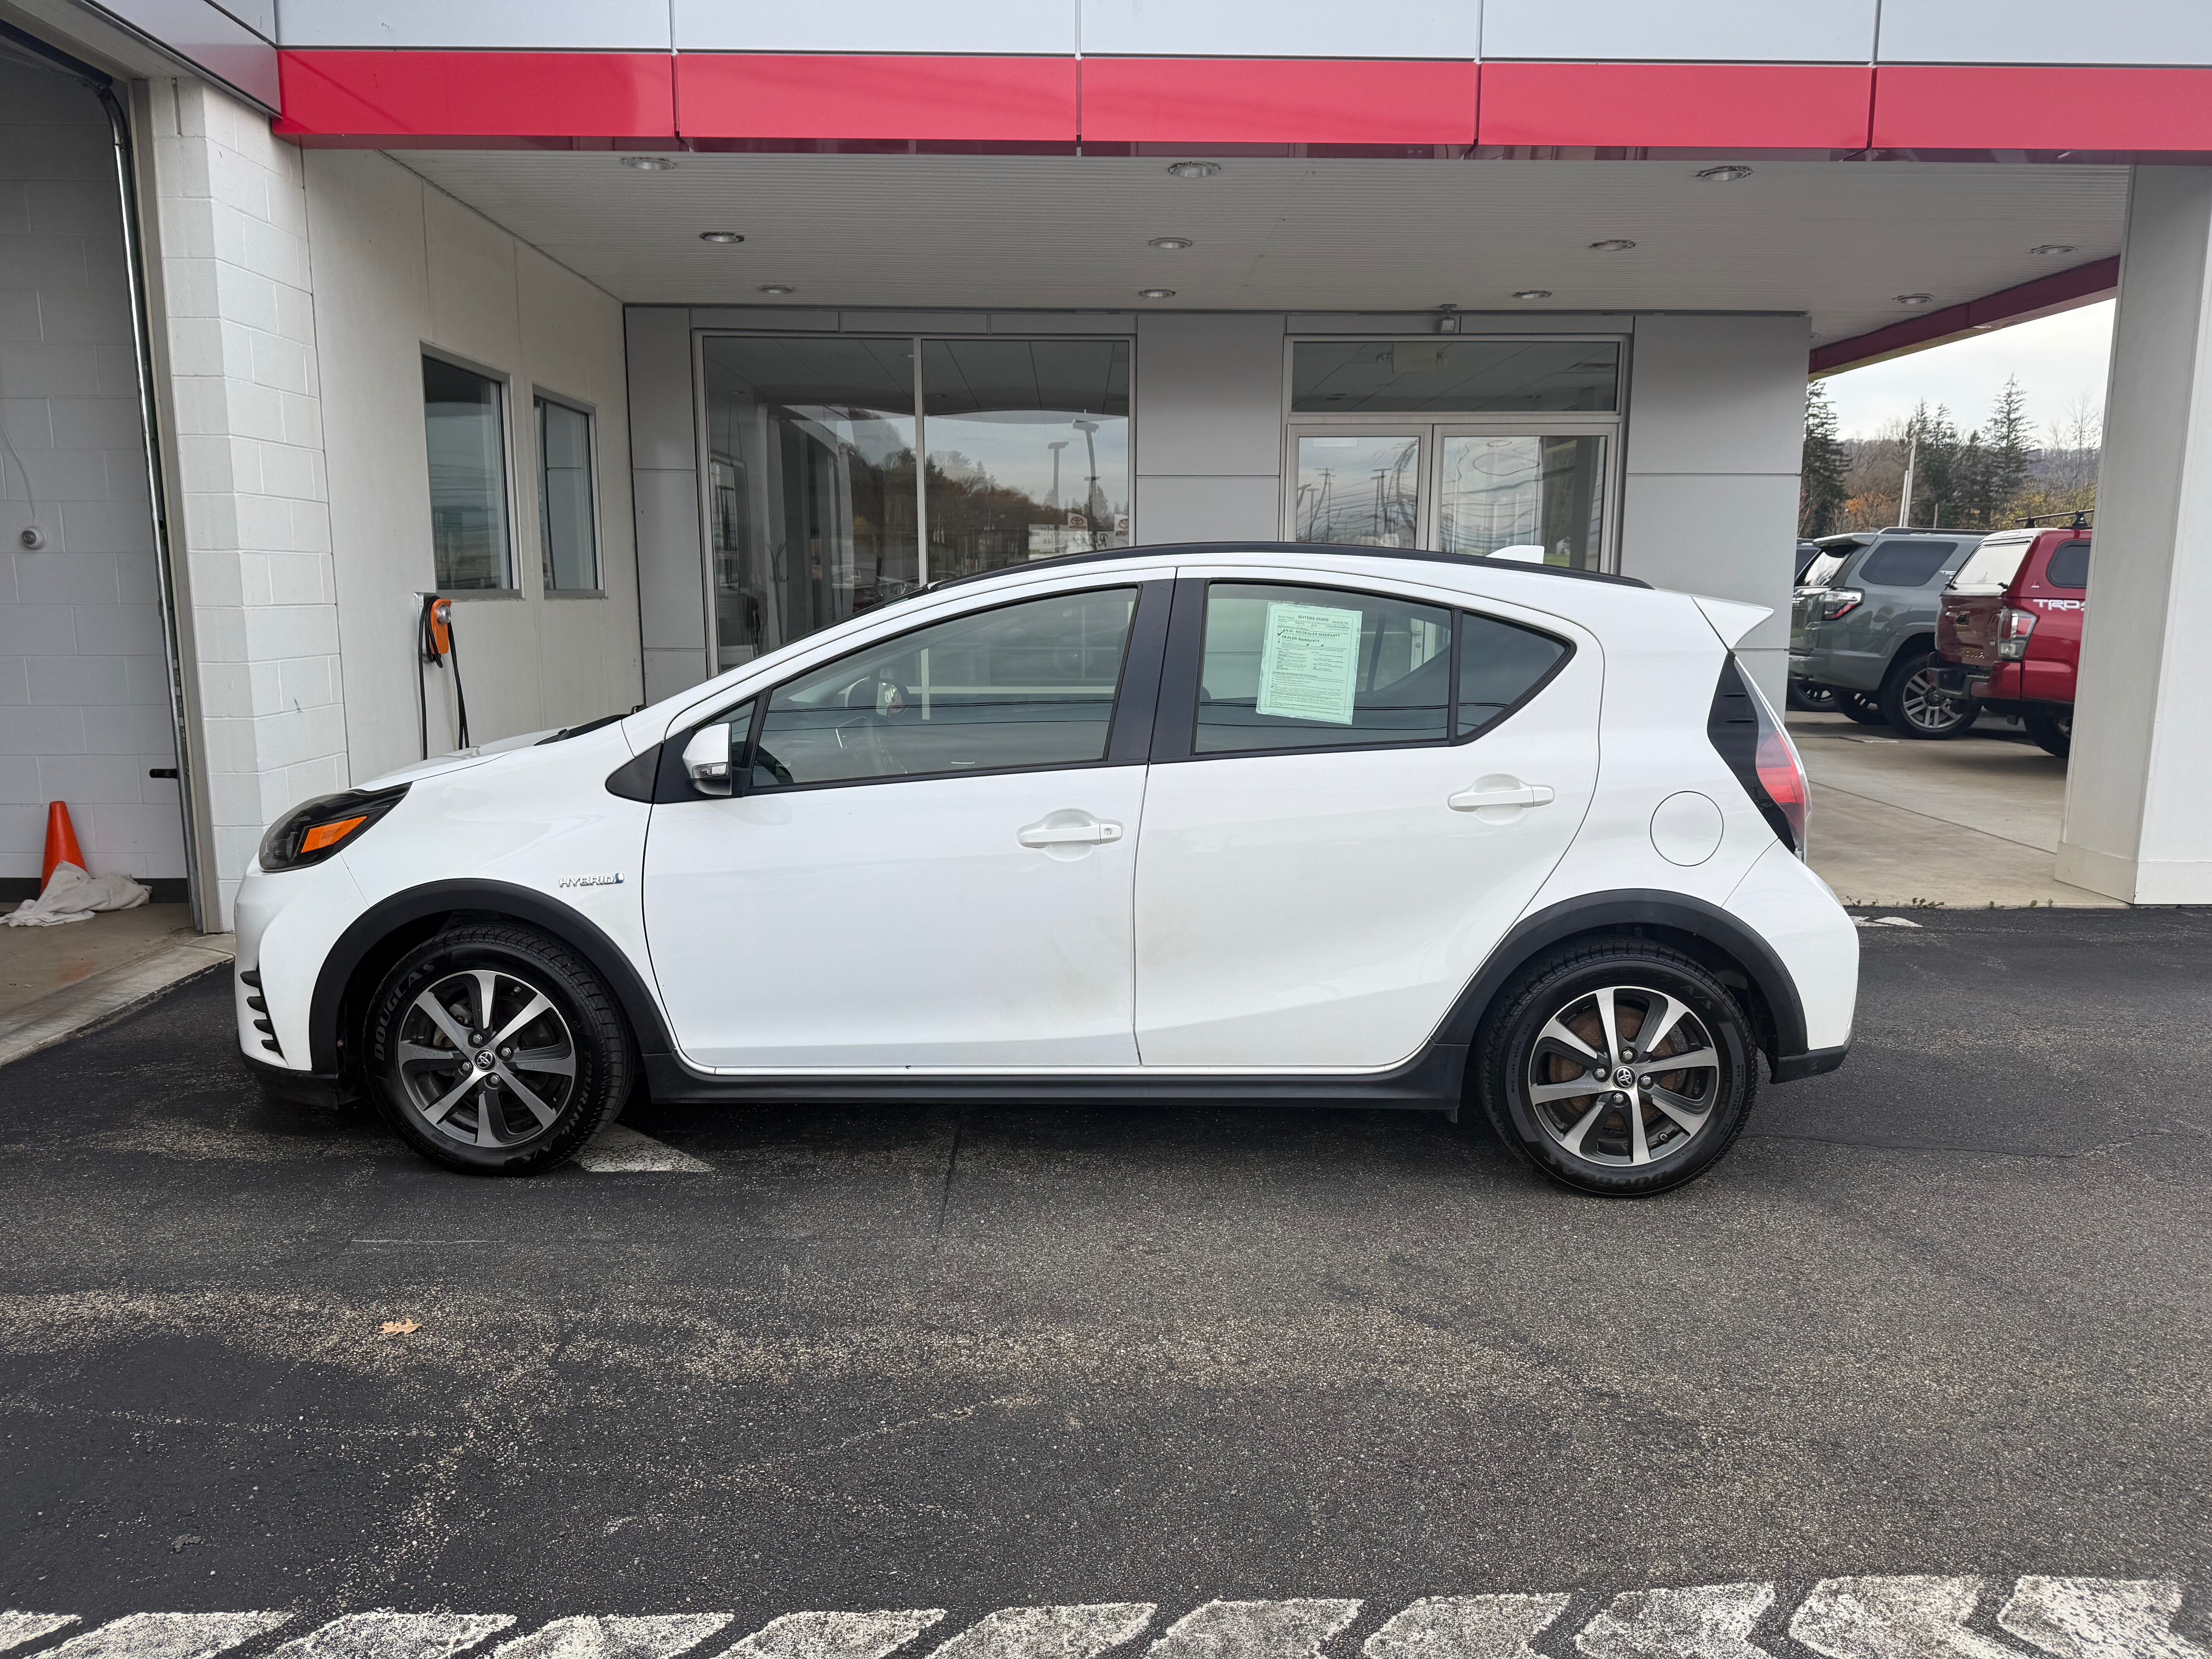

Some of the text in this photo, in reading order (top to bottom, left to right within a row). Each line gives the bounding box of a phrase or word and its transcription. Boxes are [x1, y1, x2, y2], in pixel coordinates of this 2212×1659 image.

[2033, 599, 2080, 611] TRD
[559, 875, 615, 887] HYBRID
[374, 961, 435, 1061] DOUGLAS
[562, 1050, 592, 1135] TOURING
